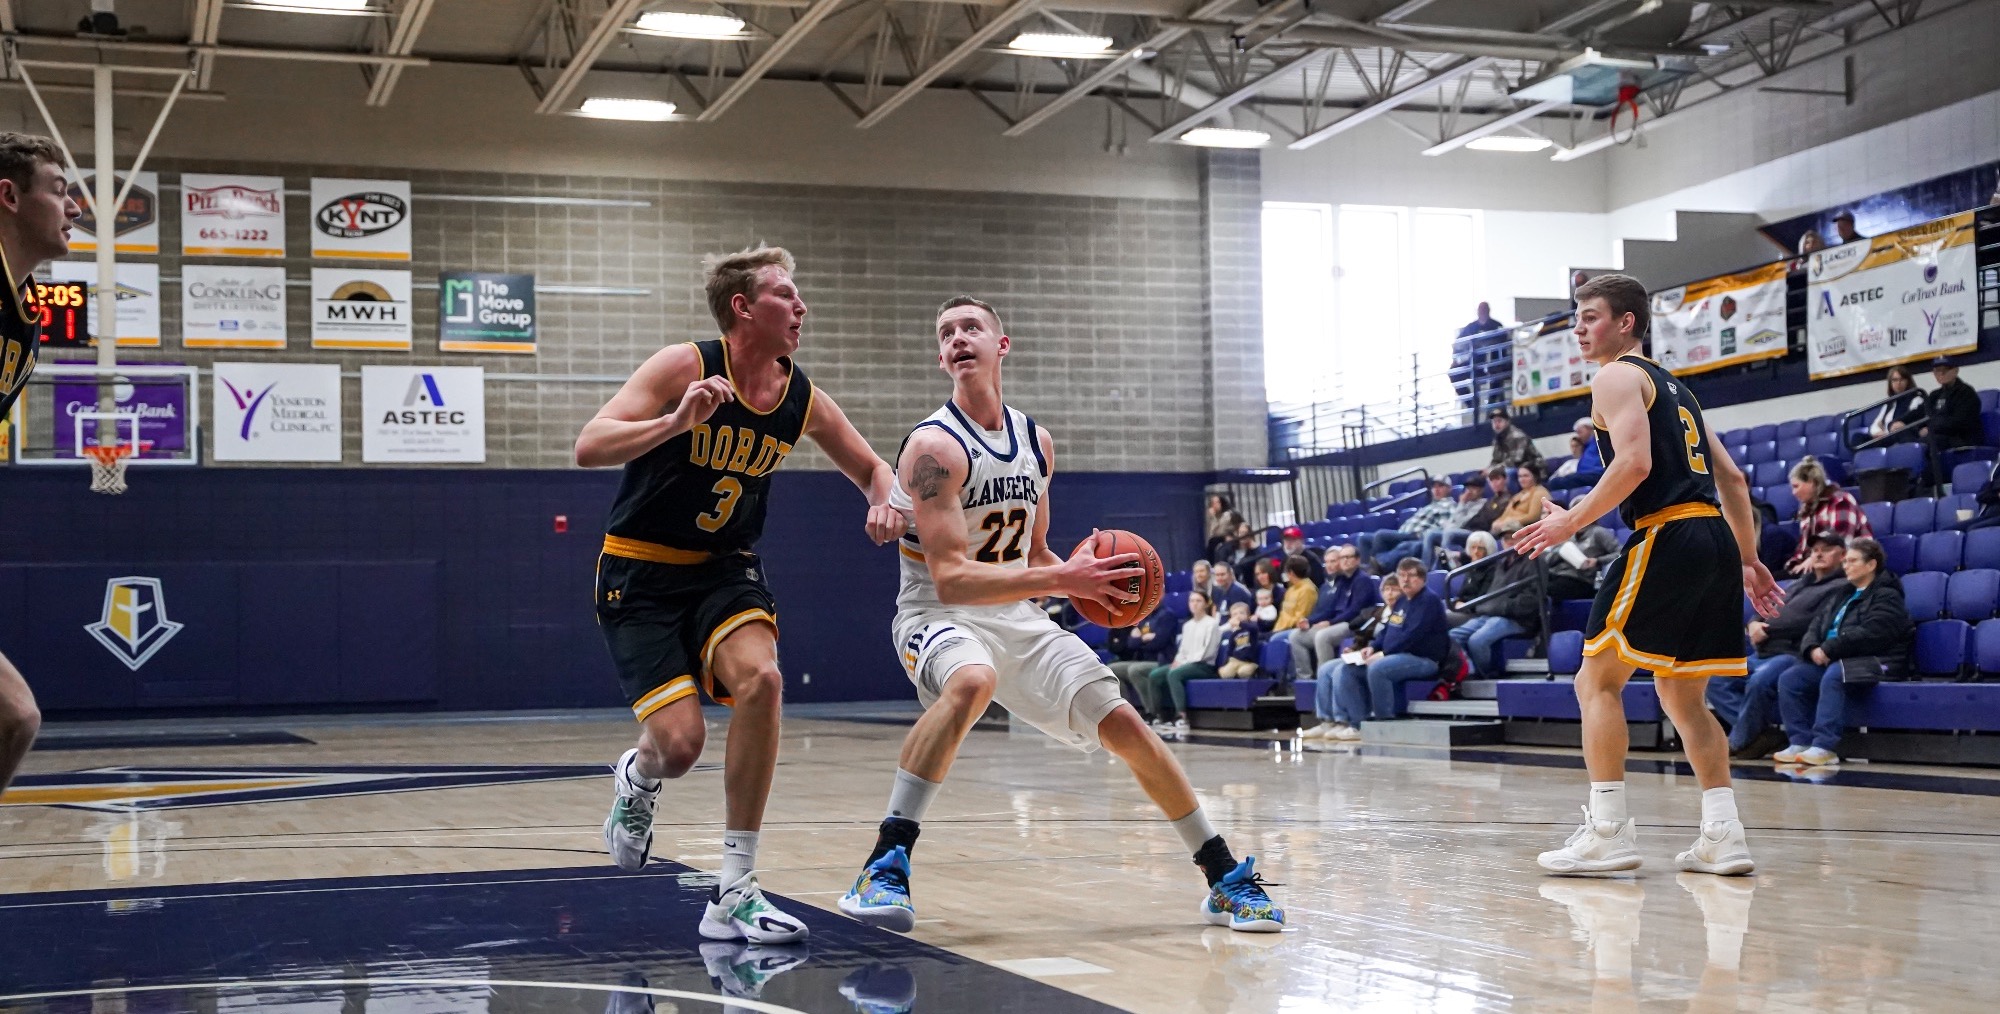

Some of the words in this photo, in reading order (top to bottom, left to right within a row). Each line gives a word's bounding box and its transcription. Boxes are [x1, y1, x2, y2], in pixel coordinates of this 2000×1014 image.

[187, 192, 229, 212] Pizz
[231, 189, 280, 213] Rnch
[328, 199, 395, 230] KYNT
[199, 228, 269, 241] 665-1222
[188, 282, 281, 300] CONKLING
[478, 280, 509, 296] The
[1840, 286, 1884, 307] ASTEC
[1901, 287, 1938, 305] CorTrust
[1940, 278, 1966, 297] Bank
[327, 305, 396, 320] MWH
[478, 294, 525, 311] Move
[478, 308, 532, 329] Group
[1887, 327, 1908, 347] Lite
[136, 402, 177, 418] Bank
[270, 394, 326, 406] YANKTON
[271, 407, 327, 419] MEDICAL
[382, 410, 465, 425] ASTEC
[1677, 404, 1710, 475] 2
[689, 423, 793, 478] DORDT
[963, 474, 1039, 511] LANCERS
[695, 475, 743, 534] 3
[974, 506, 1029, 564] 22
[1140, 548, 1160, 616] SPALDING
